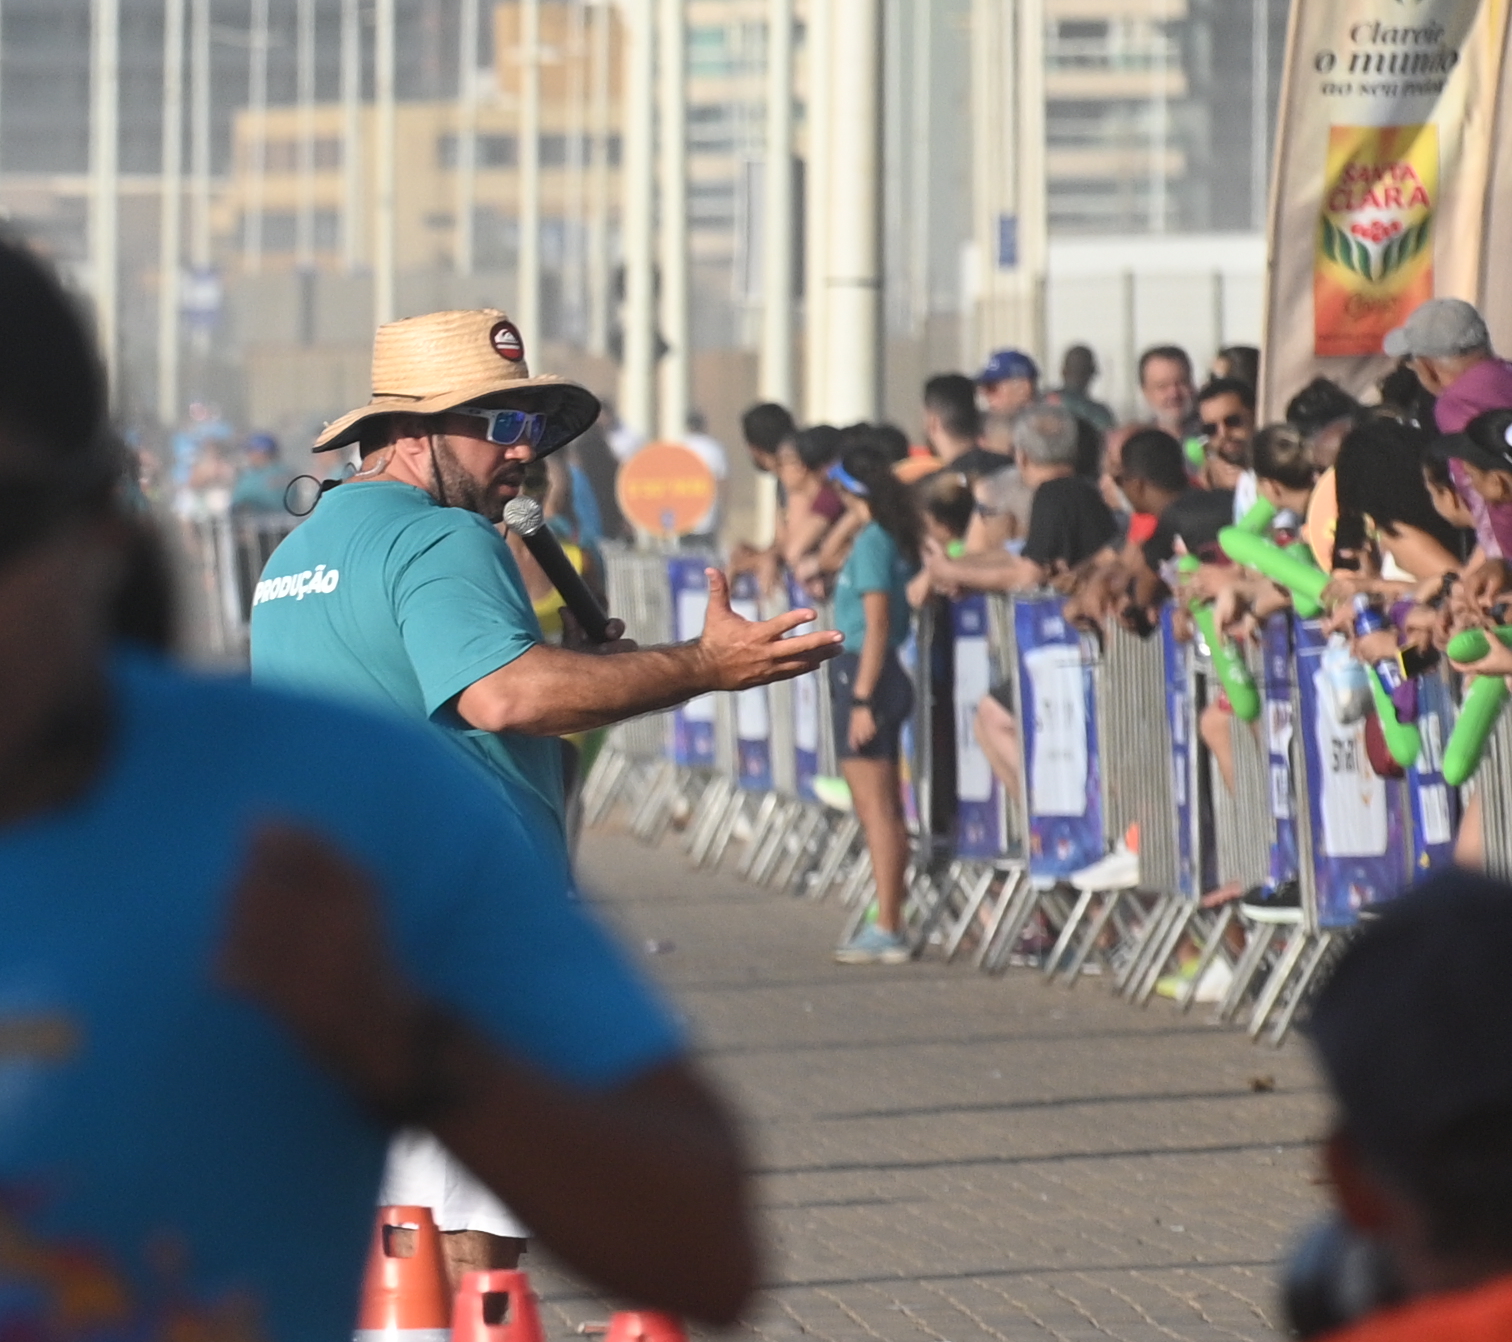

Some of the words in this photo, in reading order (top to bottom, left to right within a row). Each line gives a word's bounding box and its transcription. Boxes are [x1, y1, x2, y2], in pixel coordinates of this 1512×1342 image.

[1345, 162, 1417, 182] SANTA
[1329, 185, 1430, 210] CLARA
[253, 564, 339, 606] PRODUÇÃO
